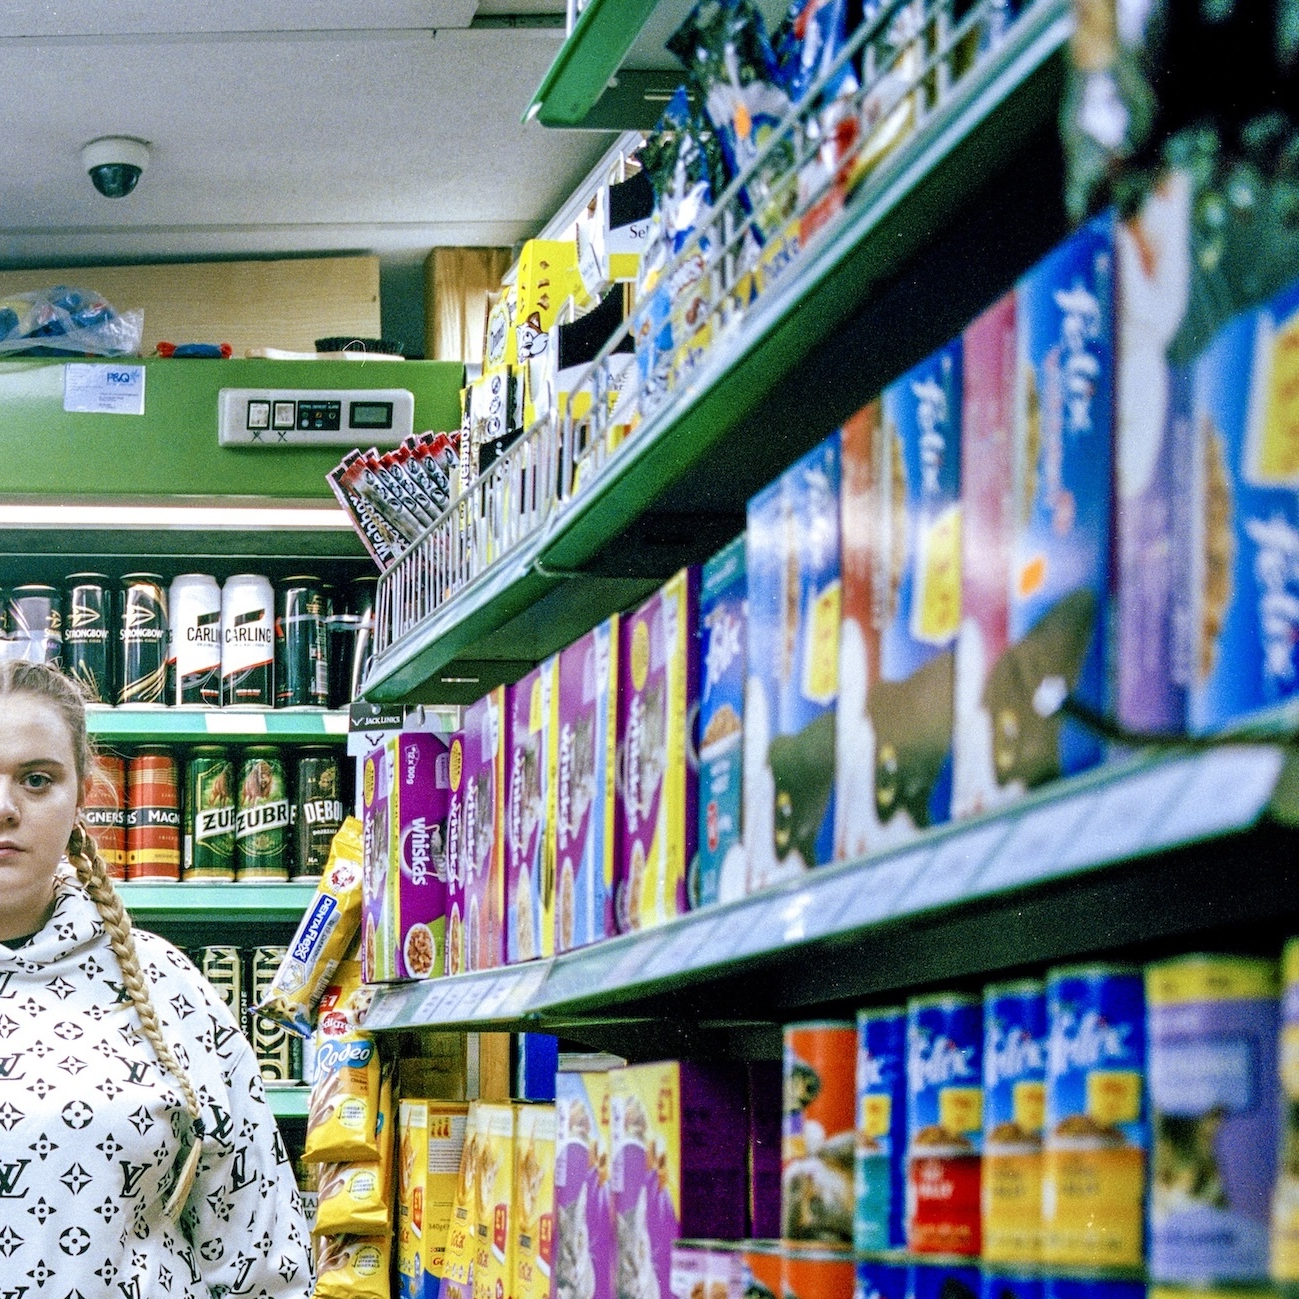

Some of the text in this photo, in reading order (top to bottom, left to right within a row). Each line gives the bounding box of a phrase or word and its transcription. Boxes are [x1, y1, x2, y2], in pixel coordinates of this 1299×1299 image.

[65, 628, 109, 640] STRONGBOW
[225, 628, 272, 644] CARLING
[364, 716, 380, 725] JACK
[314, 1044, 371, 1083] Rodeo
